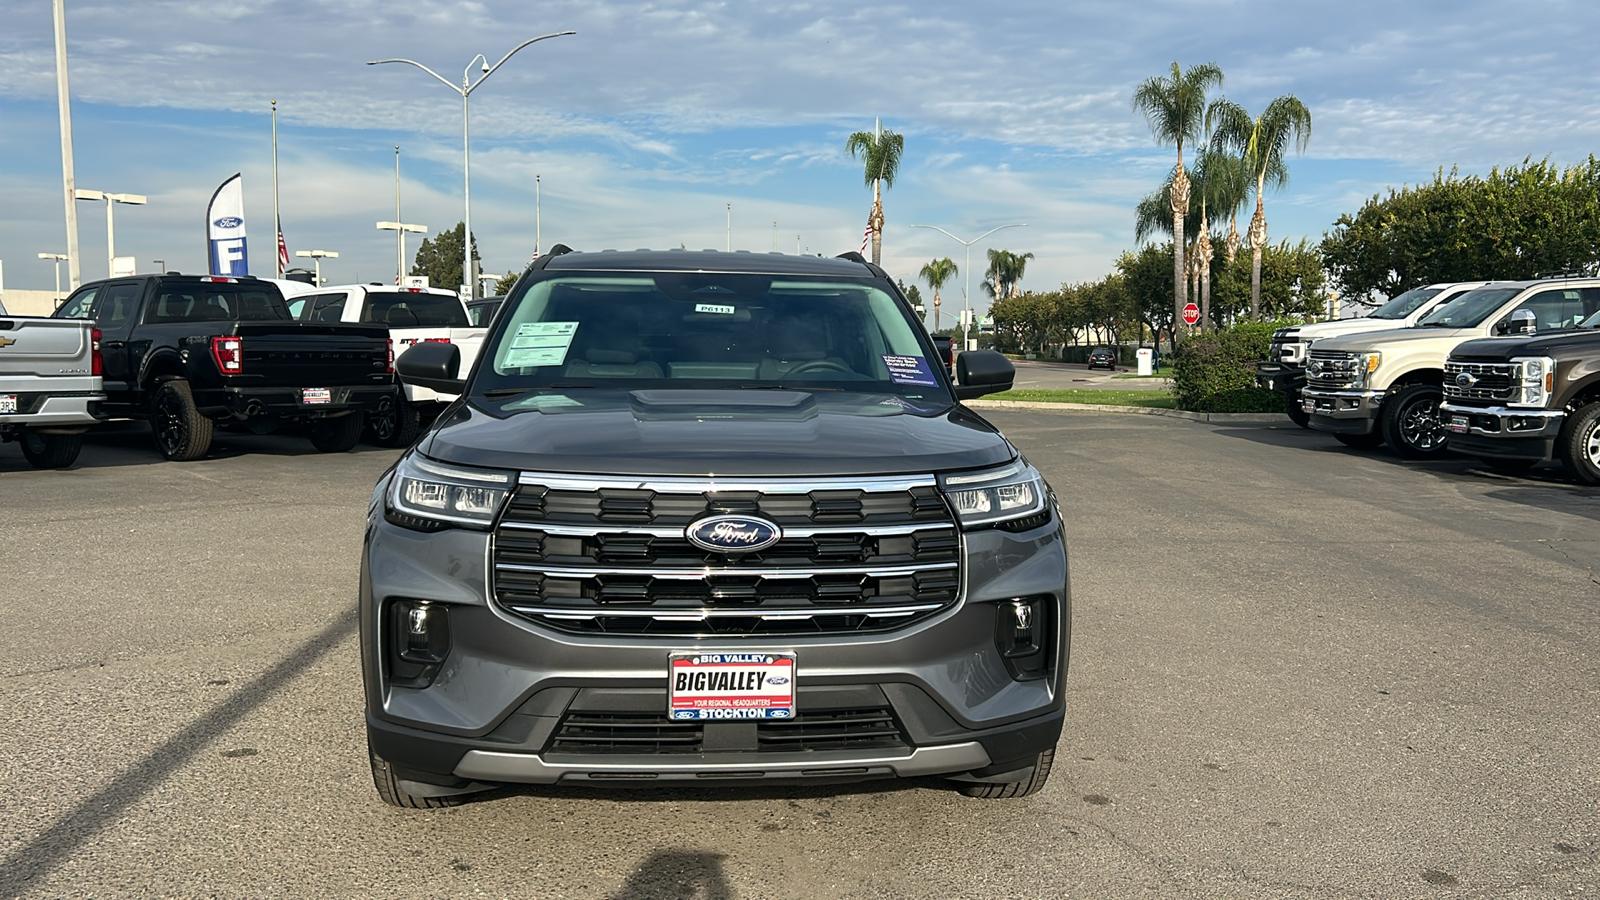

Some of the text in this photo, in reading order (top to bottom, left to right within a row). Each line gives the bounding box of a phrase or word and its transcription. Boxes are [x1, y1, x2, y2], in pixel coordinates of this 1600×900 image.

[217, 239, 243, 274] F
[1184, 310, 1198, 318] STOP
[708, 522, 760, 544] Ford
[700, 655, 766, 663] BIG VALLEY
[675, 671, 767, 691] BIGVALLEY
[768, 677, 788, 685] Ford
[699, 708, 766, 718] STOCKTON
